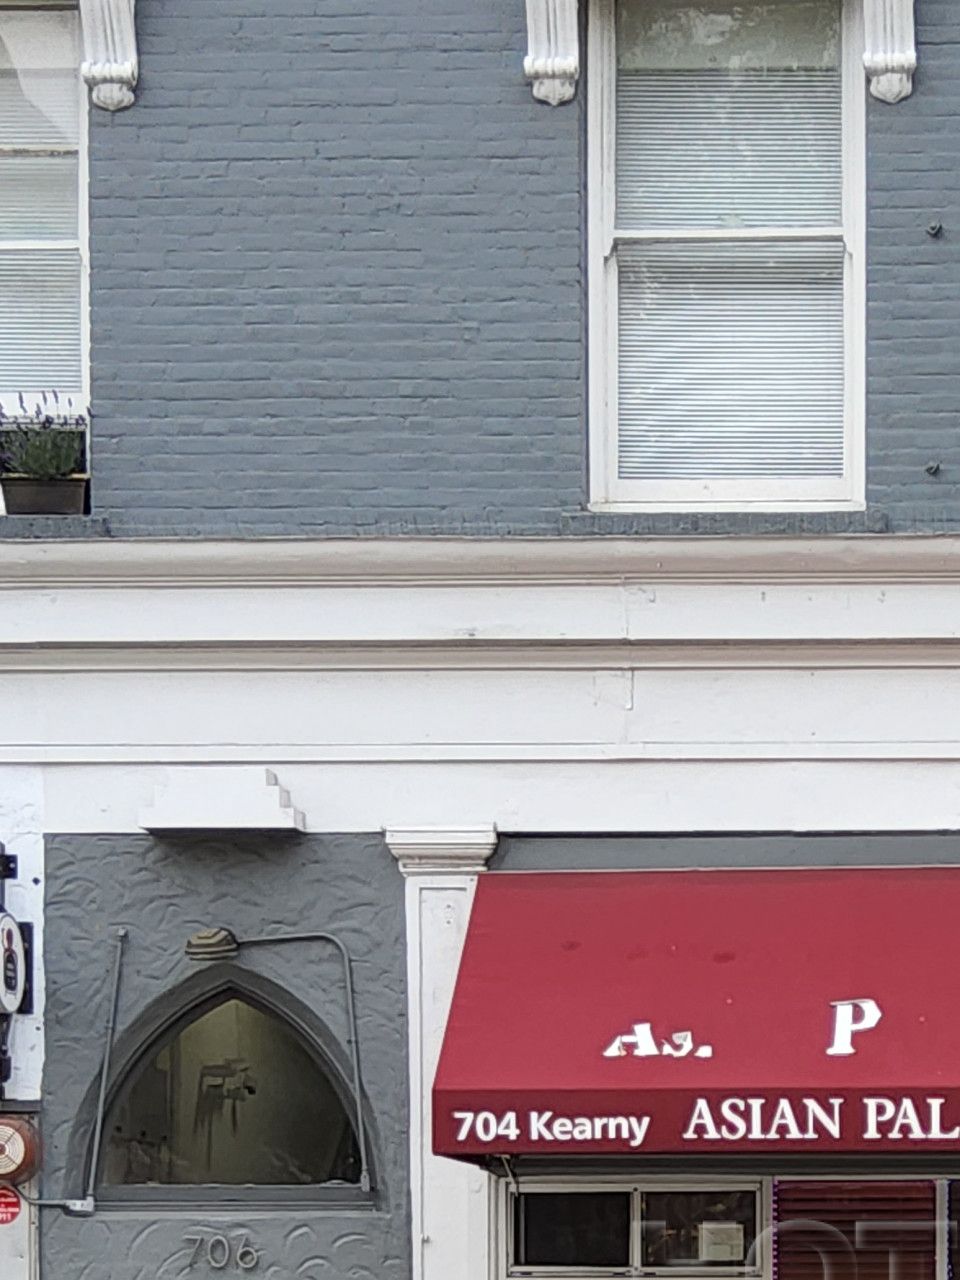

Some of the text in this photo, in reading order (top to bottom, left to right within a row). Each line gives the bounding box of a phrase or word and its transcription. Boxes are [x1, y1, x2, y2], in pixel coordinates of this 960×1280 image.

[453, 1111, 520, 1142] 704
[530, 1111, 650, 1147] Kearny
[682, 1098, 844, 1140] ASIAN
[182, 1234, 258, 1269] 706
